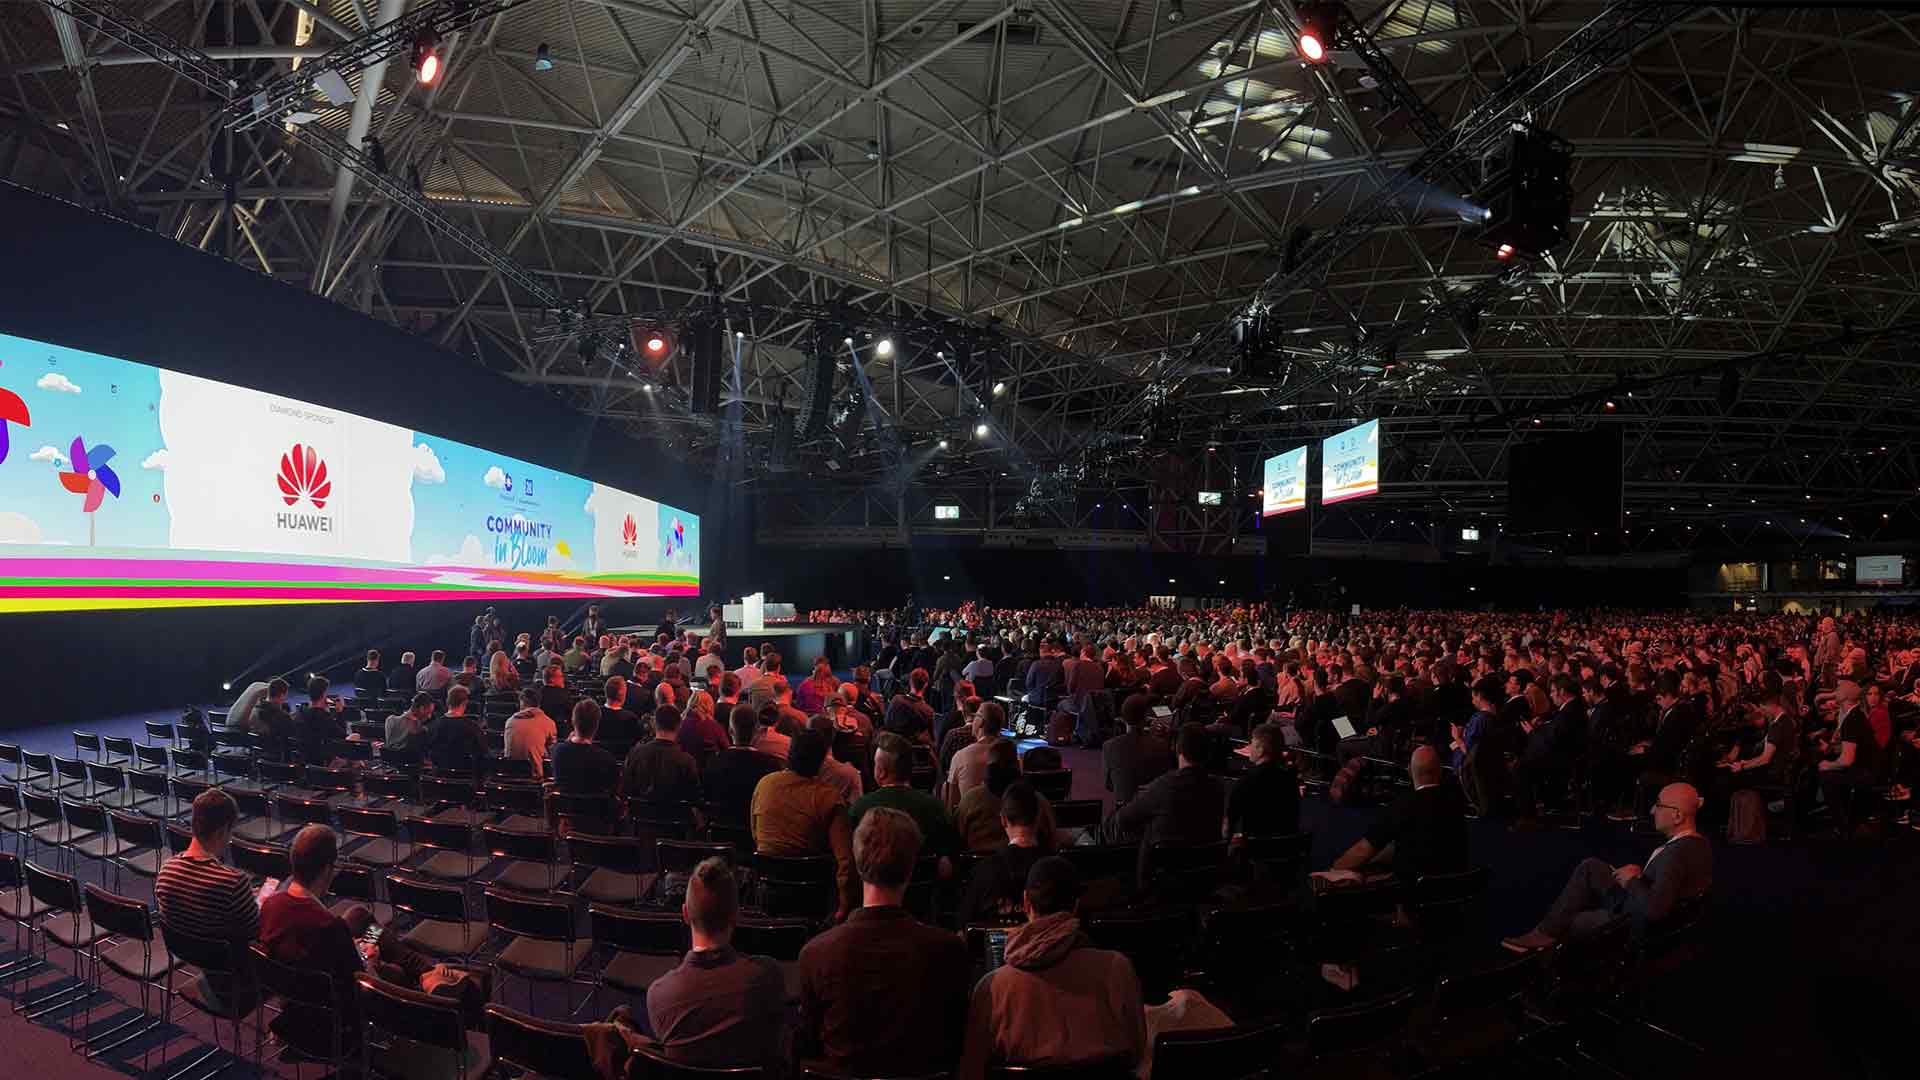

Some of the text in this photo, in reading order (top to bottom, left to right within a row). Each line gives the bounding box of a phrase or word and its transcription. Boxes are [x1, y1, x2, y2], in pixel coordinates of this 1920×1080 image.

[277, 512, 333, 532] HUAWEI
[487, 515, 552, 539] COMMUNITY
[495, 535, 507, 564] in
